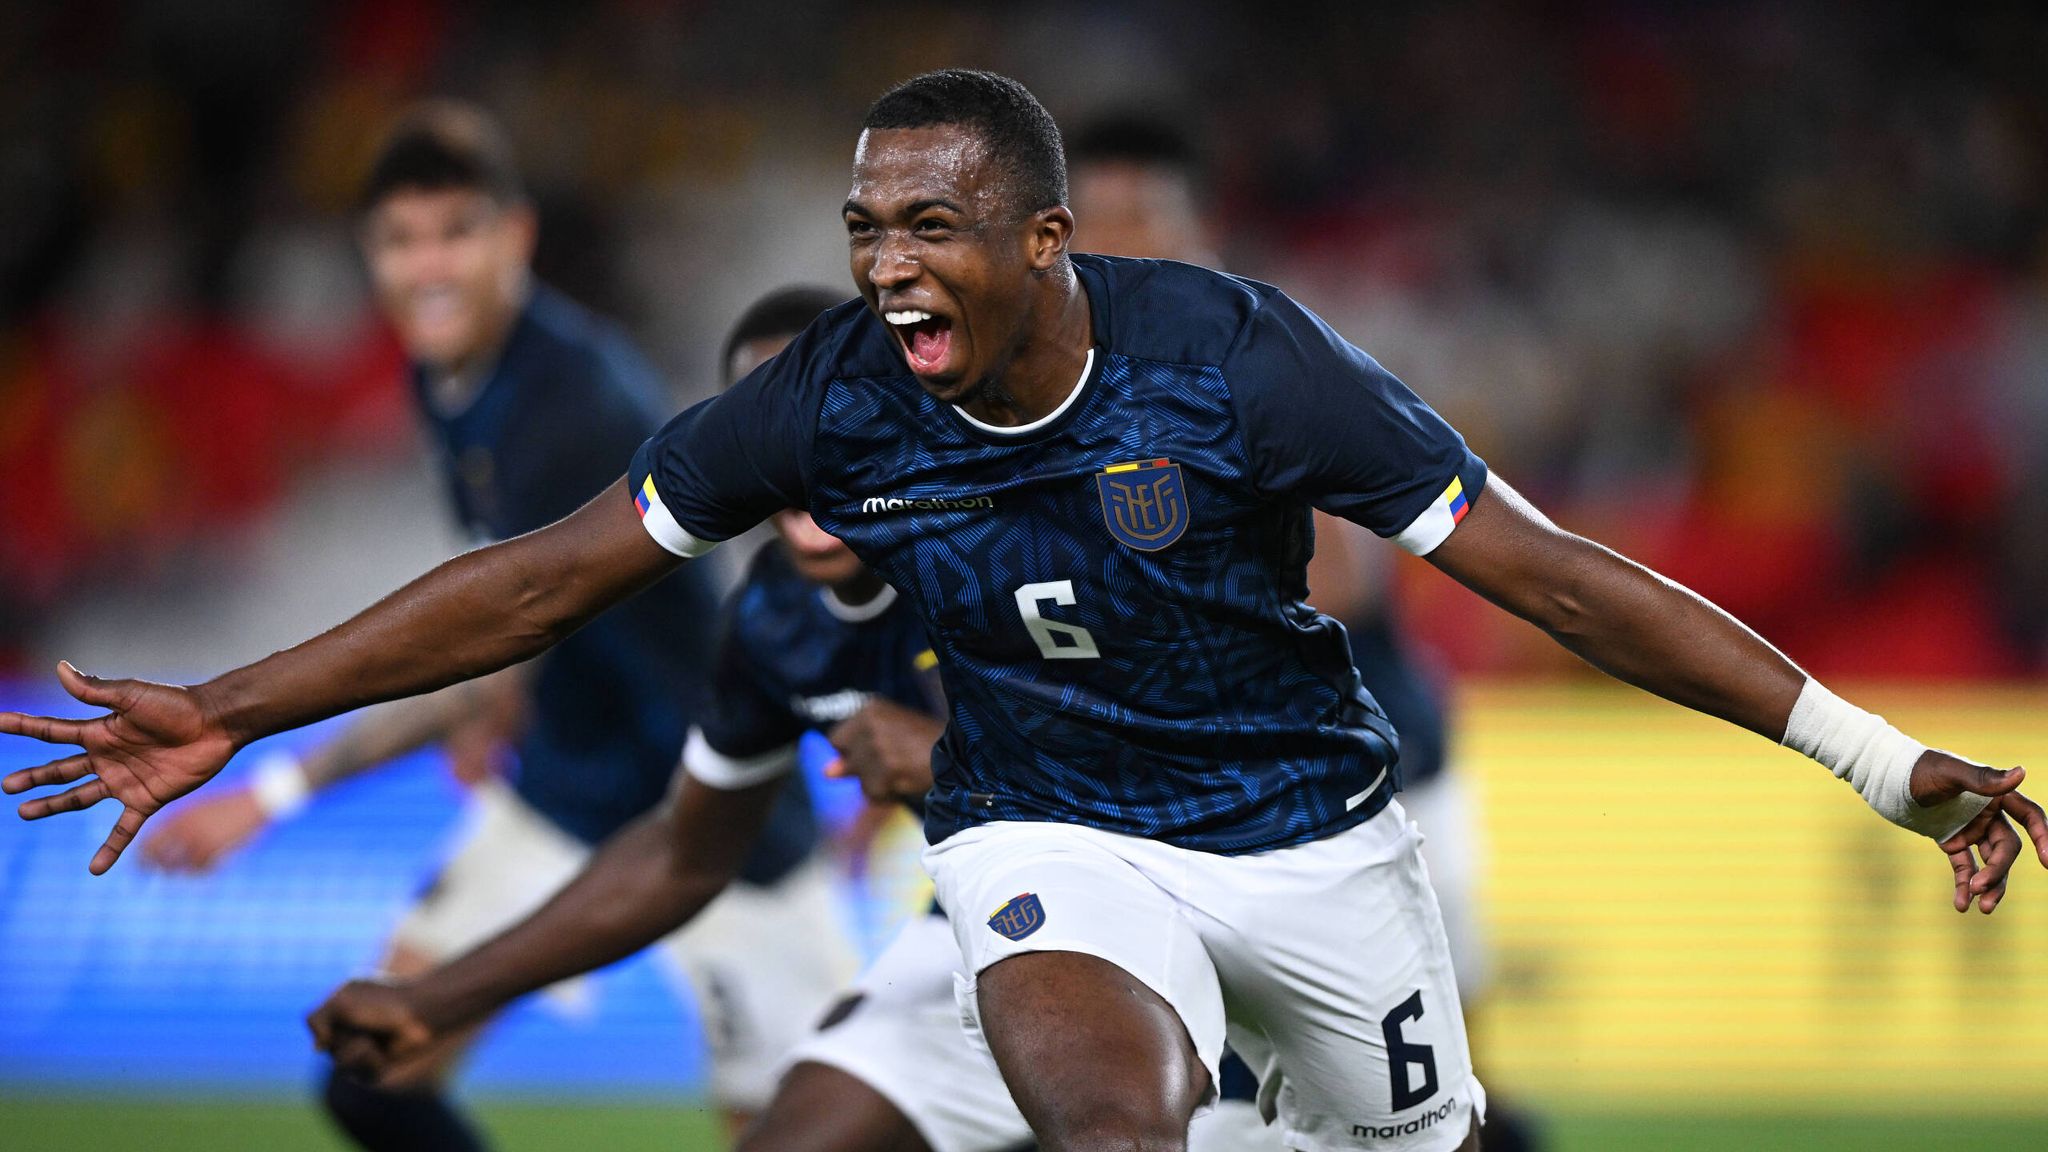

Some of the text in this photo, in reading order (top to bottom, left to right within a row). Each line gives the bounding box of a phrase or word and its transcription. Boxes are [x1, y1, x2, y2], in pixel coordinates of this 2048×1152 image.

[862, 496, 993, 513] marathon
[1014, 579, 1101, 659] 6
[1381, 989, 1439, 1112] 6
[1352, 1097, 1456, 1139] marathon
